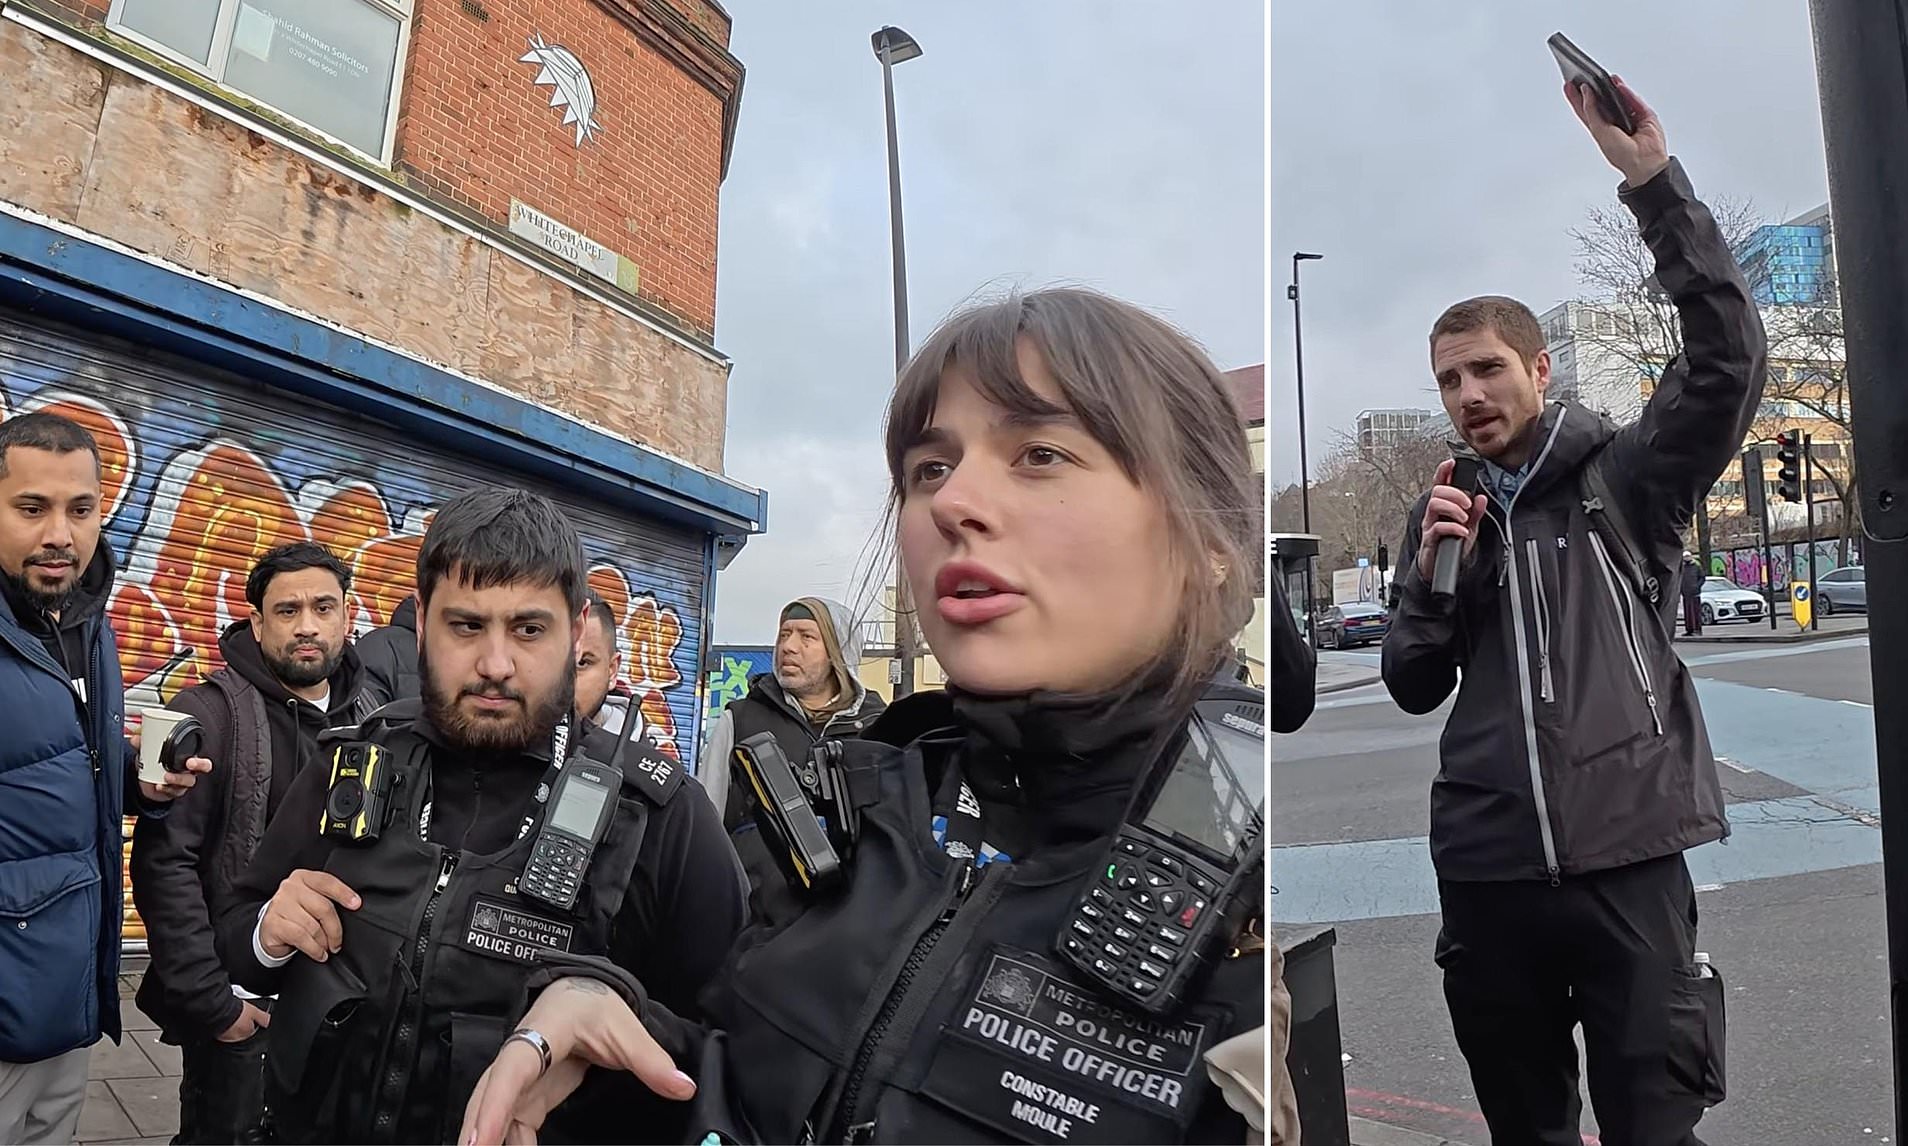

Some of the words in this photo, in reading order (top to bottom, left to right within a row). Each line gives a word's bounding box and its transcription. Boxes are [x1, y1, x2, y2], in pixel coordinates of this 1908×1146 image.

[295, 27, 330, 52] Rahman
[331, 47, 369, 73] Solicitors
[515, 204, 604, 260] WHITECHAPEL
[544, 235, 579, 260] ROAD
[552, 725, 569, 771] OFFICER
[638, 757, 658, 773] CE
[650, 760, 674, 787] 2767
[502, 912, 569, 938] METROPOLITAN
[509, 926, 558, 947] POLICE
[467, 931, 512, 956] POLICE
[514, 944, 538, 961] OFF
[1055, 1010, 1168, 1063] POLICE
[963, 1008, 1059, 1063] POLICE
[1062, 1047, 1184, 1109] OFFICER
[1000, 1071, 1101, 1124] CONSTABLE
[1010, 1100, 1073, 1140] MOULE
